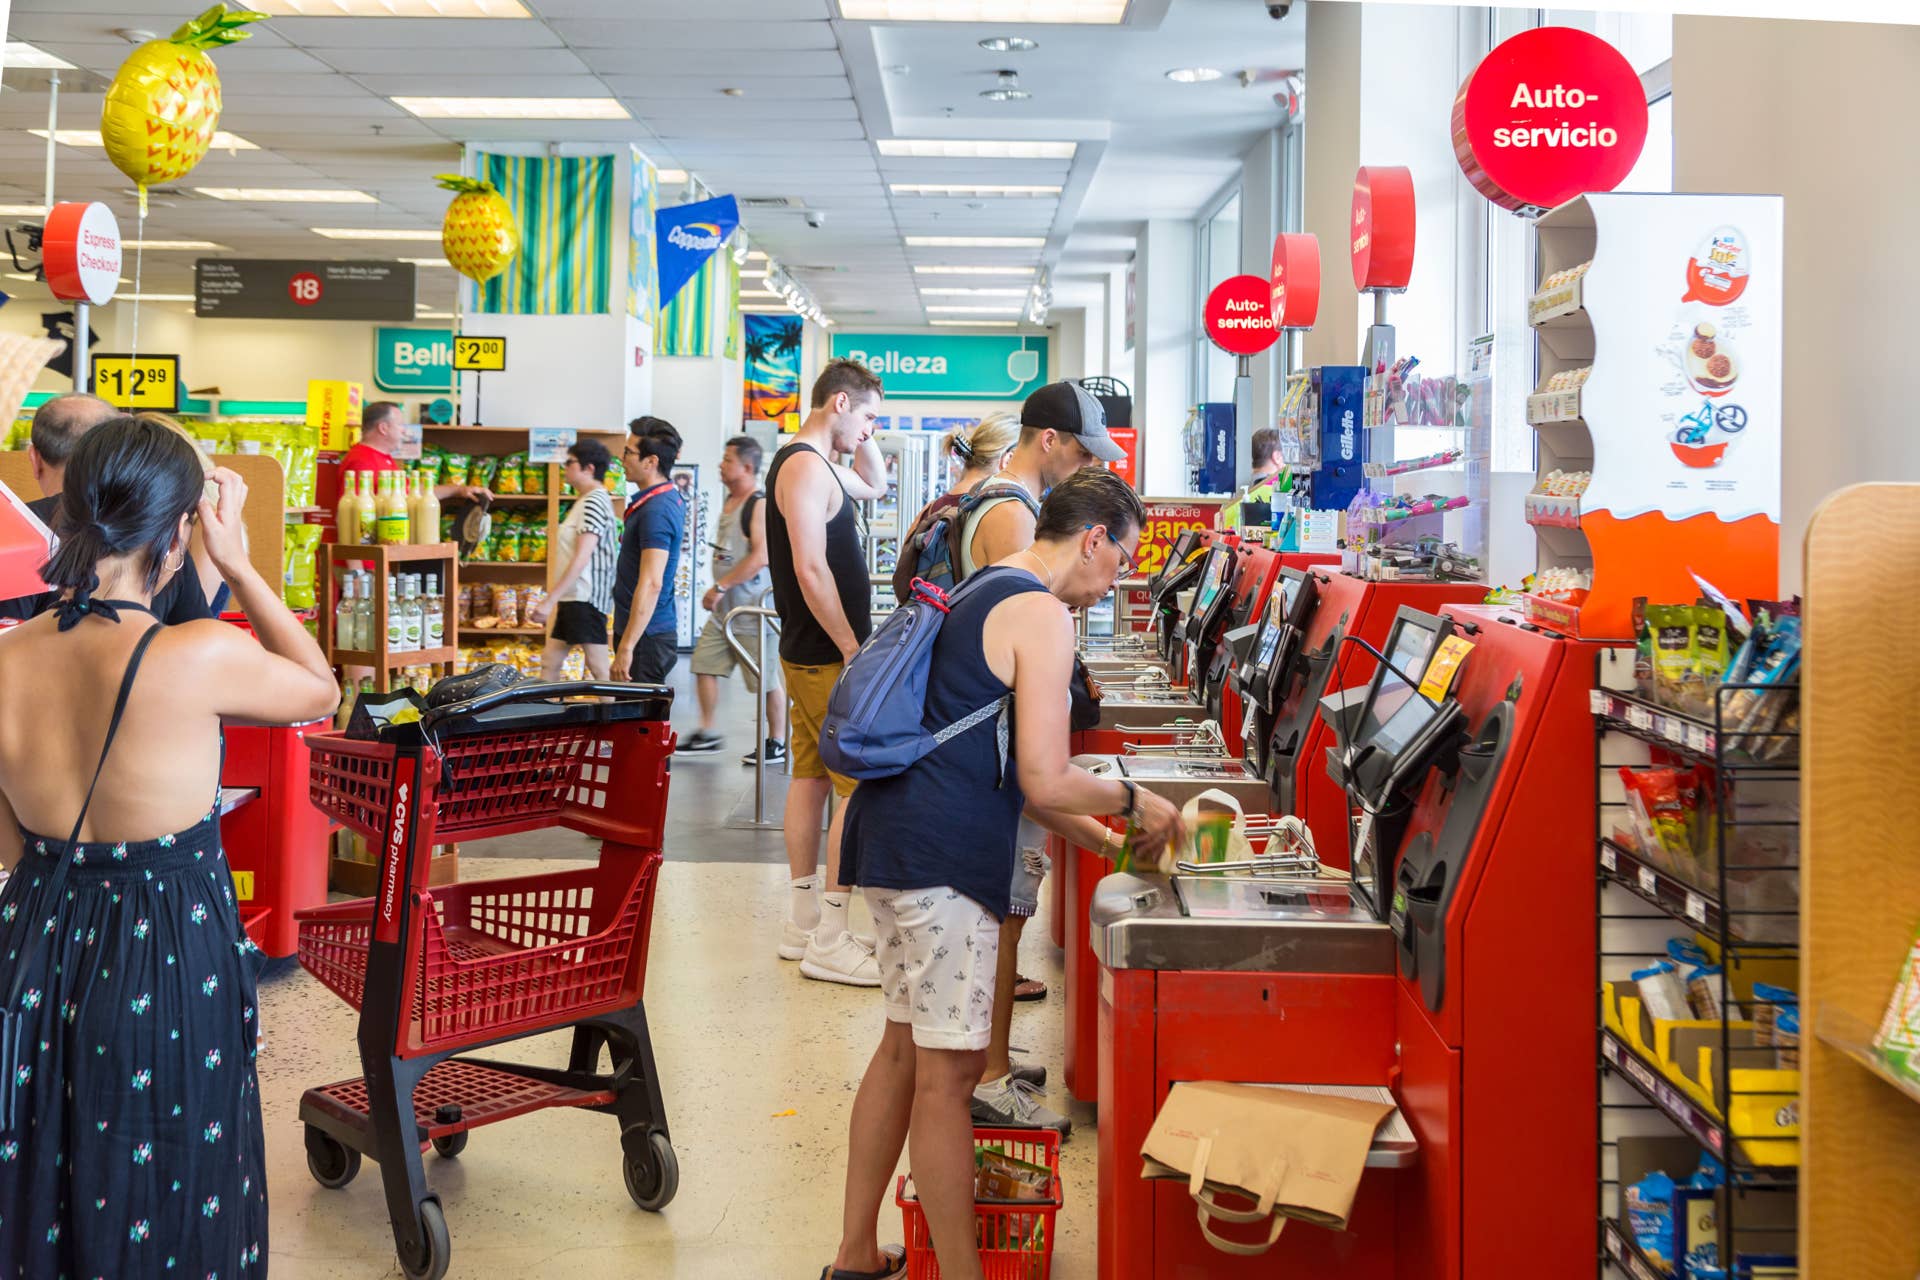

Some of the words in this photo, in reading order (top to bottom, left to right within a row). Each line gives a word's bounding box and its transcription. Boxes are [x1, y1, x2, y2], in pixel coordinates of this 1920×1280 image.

[1510, 83, 1599, 108] Auto-
[1493, 121, 1618, 148] servicio
[84, 230, 116, 250] Express
[80, 252, 119, 273] Checkout
[292, 279, 320, 300] 18
[1225, 298, 1265, 312] Auto-
[1217, 315, 1273, 330] servicio
[848, 349, 948, 375] Belleza
[1216, 429, 1226, 462] Gillette
[1340, 409, 1354, 461] Gillette
[1146, 505, 1201, 518] xtracare
[392, 803, 406, 845] CVS
[383, 845, 400, 923] pharmacy
